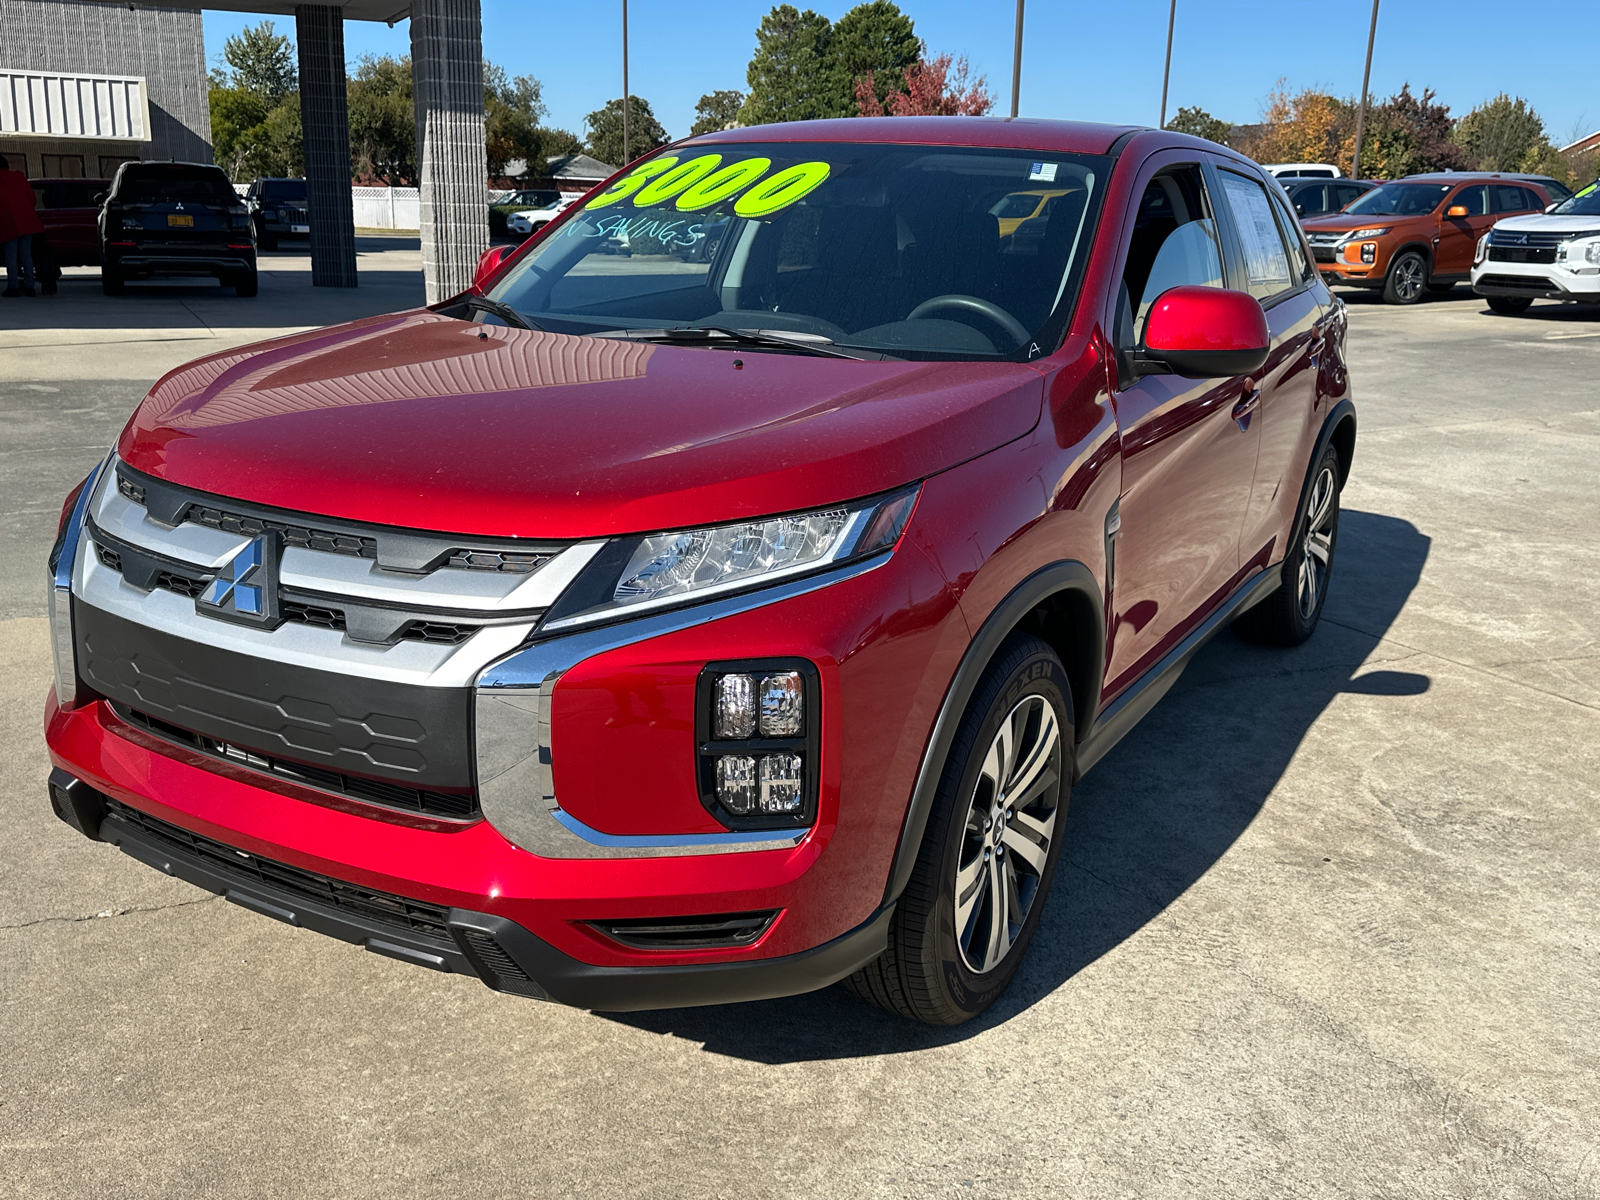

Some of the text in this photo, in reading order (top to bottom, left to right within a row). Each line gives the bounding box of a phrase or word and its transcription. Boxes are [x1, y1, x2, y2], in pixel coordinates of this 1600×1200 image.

[585, 153, 831, 218] 3000
[582, 214, 703, 246] SAVINGS
[1028, 342, 1042, 359] A
[992, 661, 1053, 729] NEXEN
